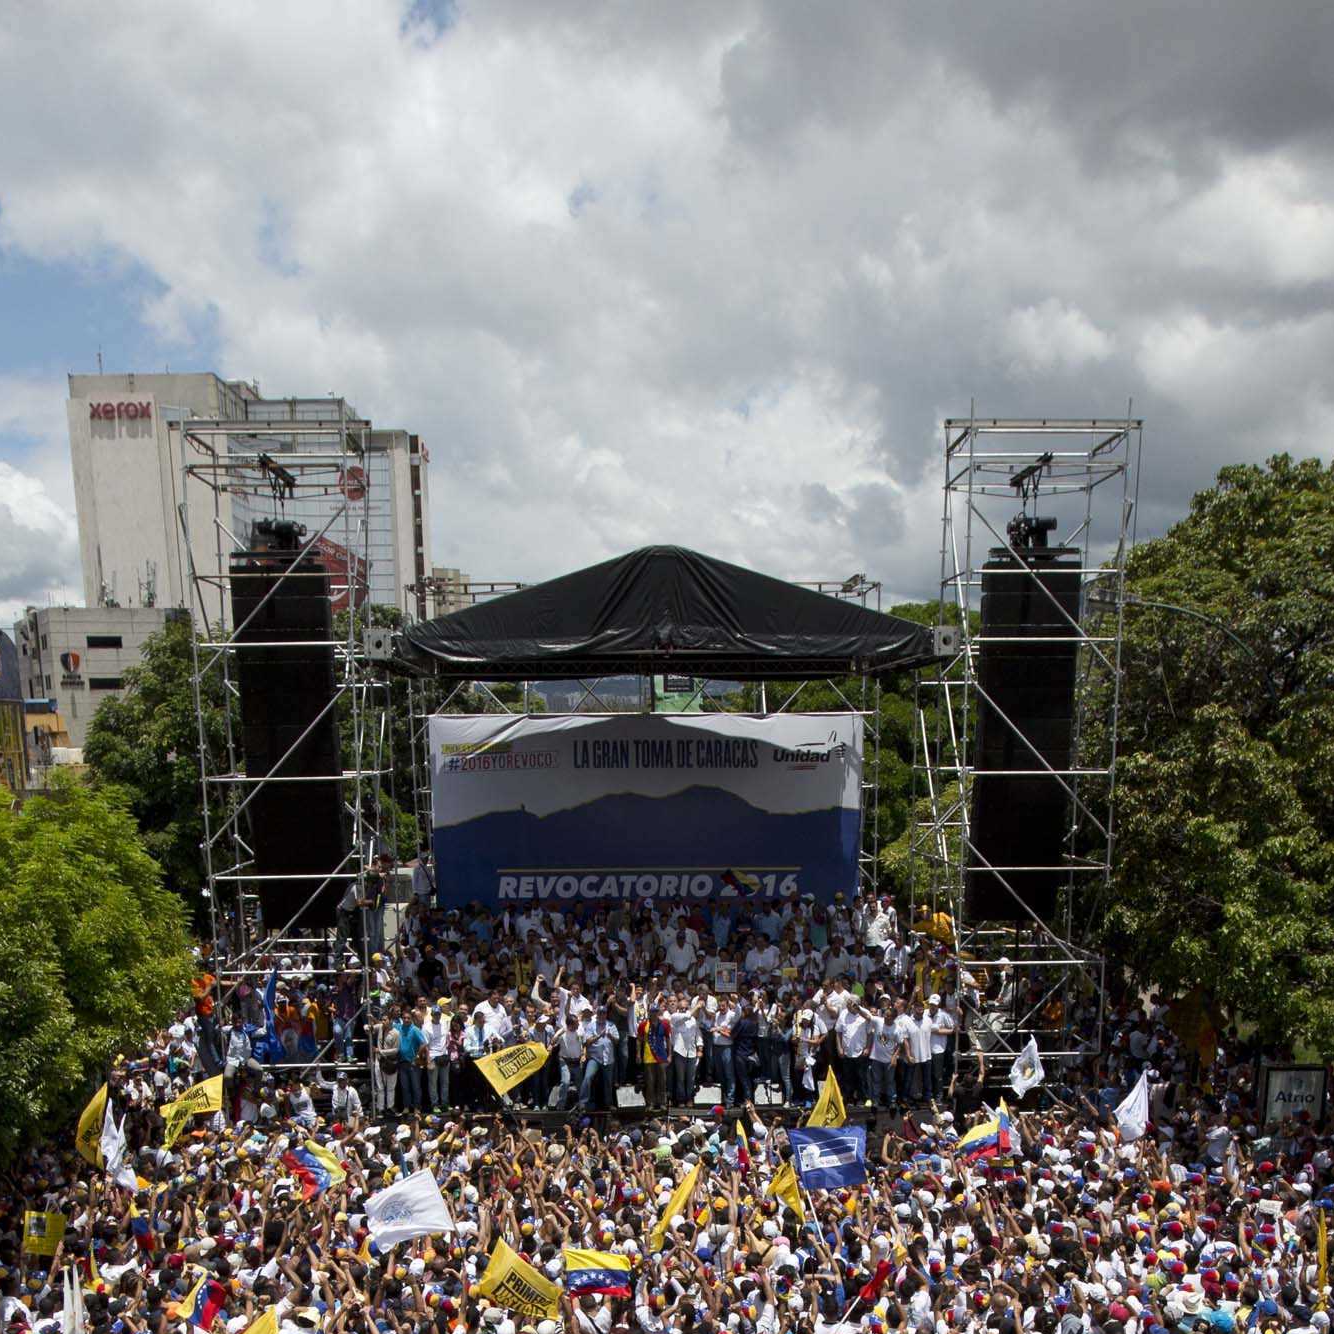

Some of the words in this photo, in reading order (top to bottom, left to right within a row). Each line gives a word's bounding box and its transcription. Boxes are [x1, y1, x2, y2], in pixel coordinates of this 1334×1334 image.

[89, 401, 152, 420] xerox
[573, 739, 589, 769] LA
[592, 739, 629, 769] GRAN
[633, 739, 672, 769] TOMA
[676, 739, 694, 769] DE
[696, 739, 759, 769] CARACAS
[773, 746, 831, 763] Unidad
[498, 873, 714, 898] REVOCATORIO
[501, 1049, 535, 1077] JUSTICIA
